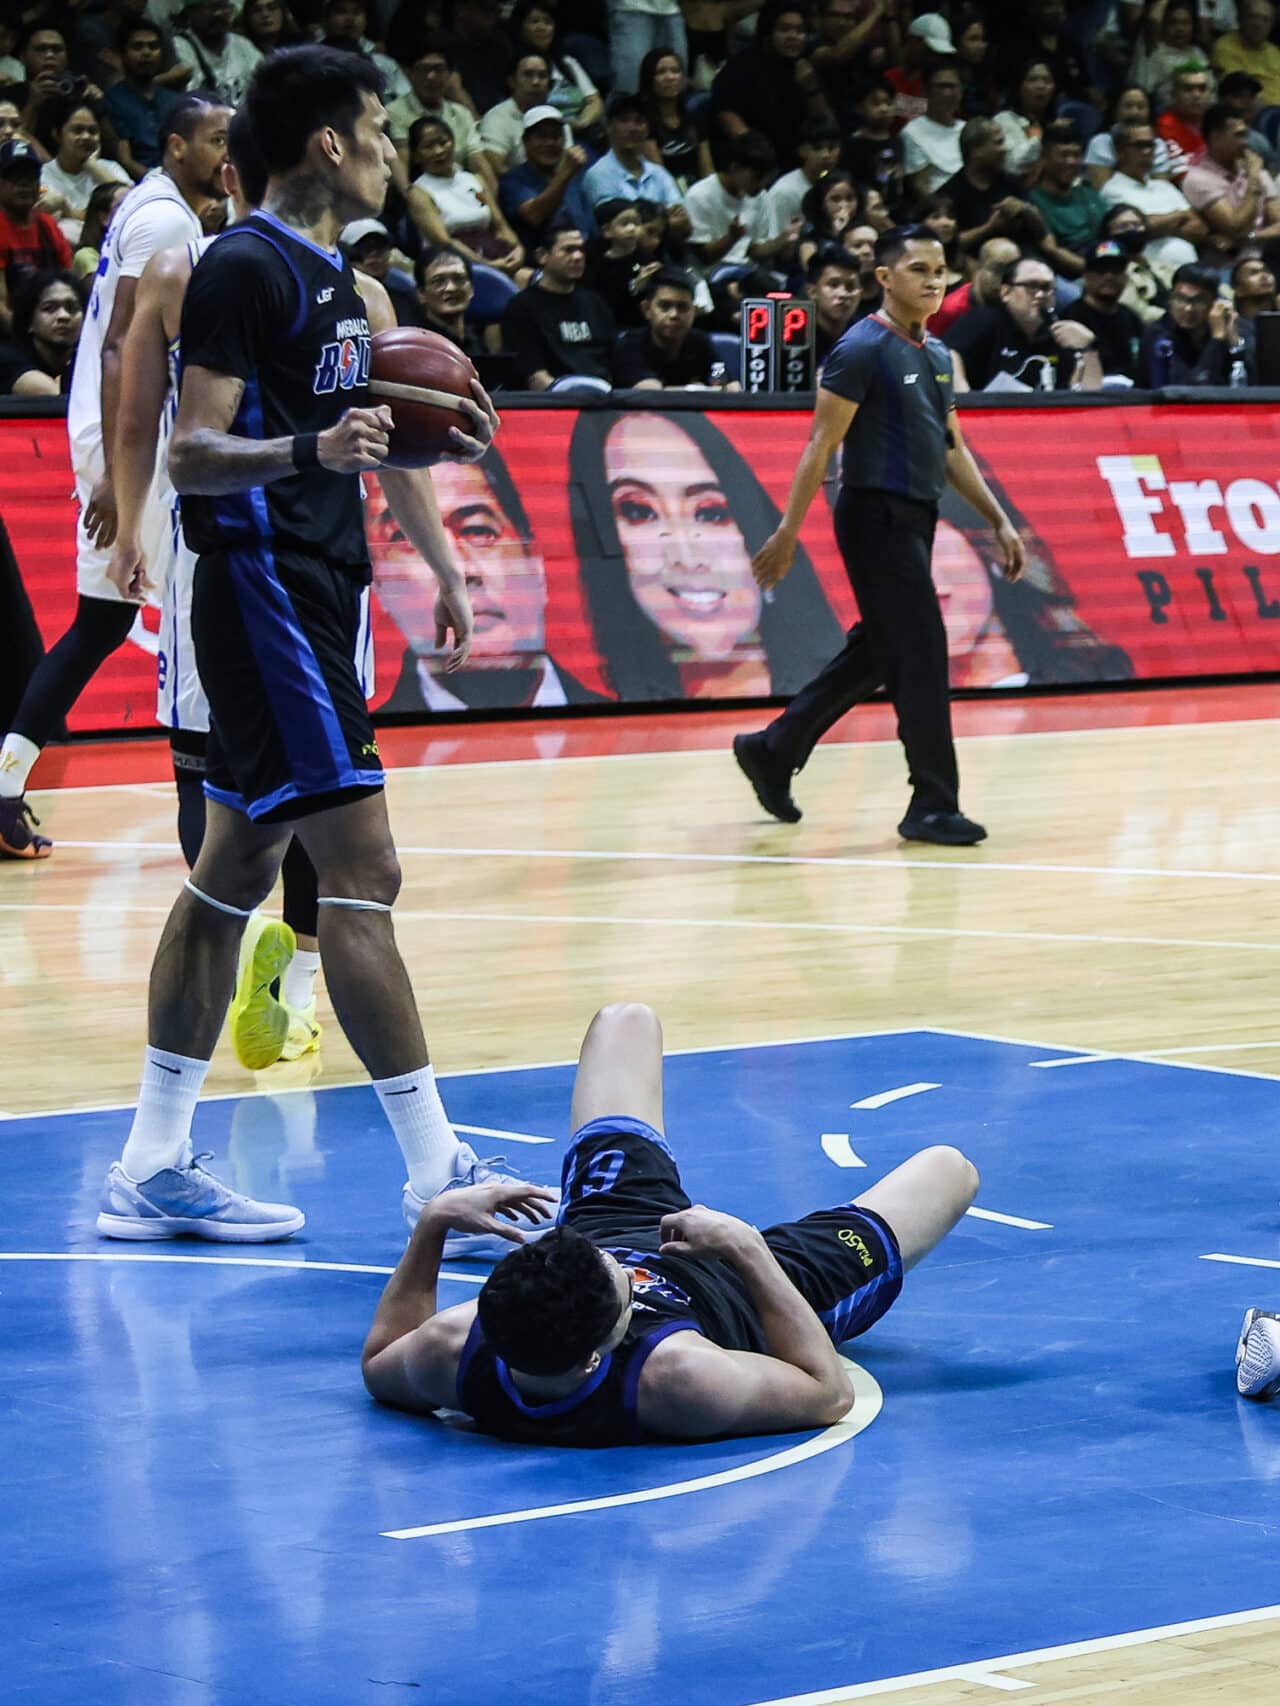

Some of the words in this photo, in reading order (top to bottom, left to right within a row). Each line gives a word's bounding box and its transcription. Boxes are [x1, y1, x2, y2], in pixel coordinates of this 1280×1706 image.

[336, 318, 371, 340] MERALC
[749, 307, 769, 340] P
[783, 308, 808, 342] P
[313, 336, 372, 395] BOL
